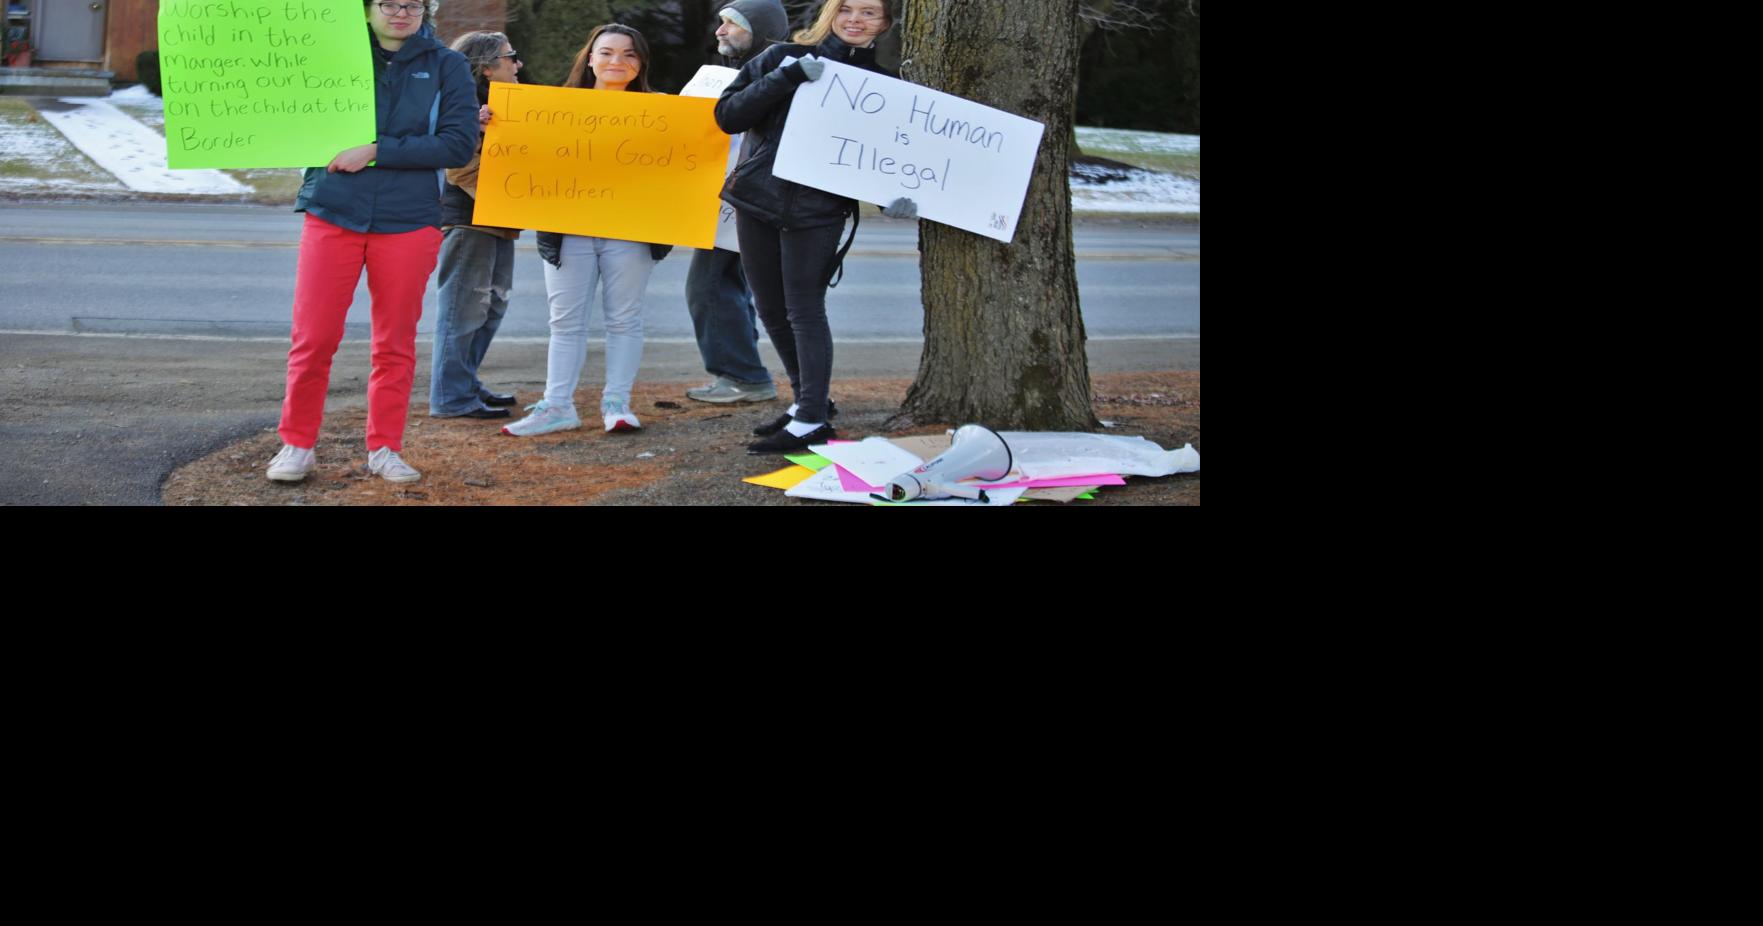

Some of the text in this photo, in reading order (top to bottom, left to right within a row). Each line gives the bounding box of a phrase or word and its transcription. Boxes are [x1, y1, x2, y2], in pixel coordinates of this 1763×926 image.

[162, 0, 337, 24] Worship the
[231, 26, 254, 44] in
[265, 25, 317, 48] the
[167, 70, 371, 99] turning our backs
[167, 100, 200, 119] on
[210, 99, 249, 117] the
[302, 98, 328, 114] at
[334, 98, 370, 113] the
[498, 86, 669, 134] Immigrants
[820, 72, 1005, 153] No Human
[180, 126, 257, 152] Border
[894, 125, 911, 146] is
[487, 138, 698, 172] are all God's
[829, 135, 952, 192] Illegal
[503, 171, 615, 200] Children
